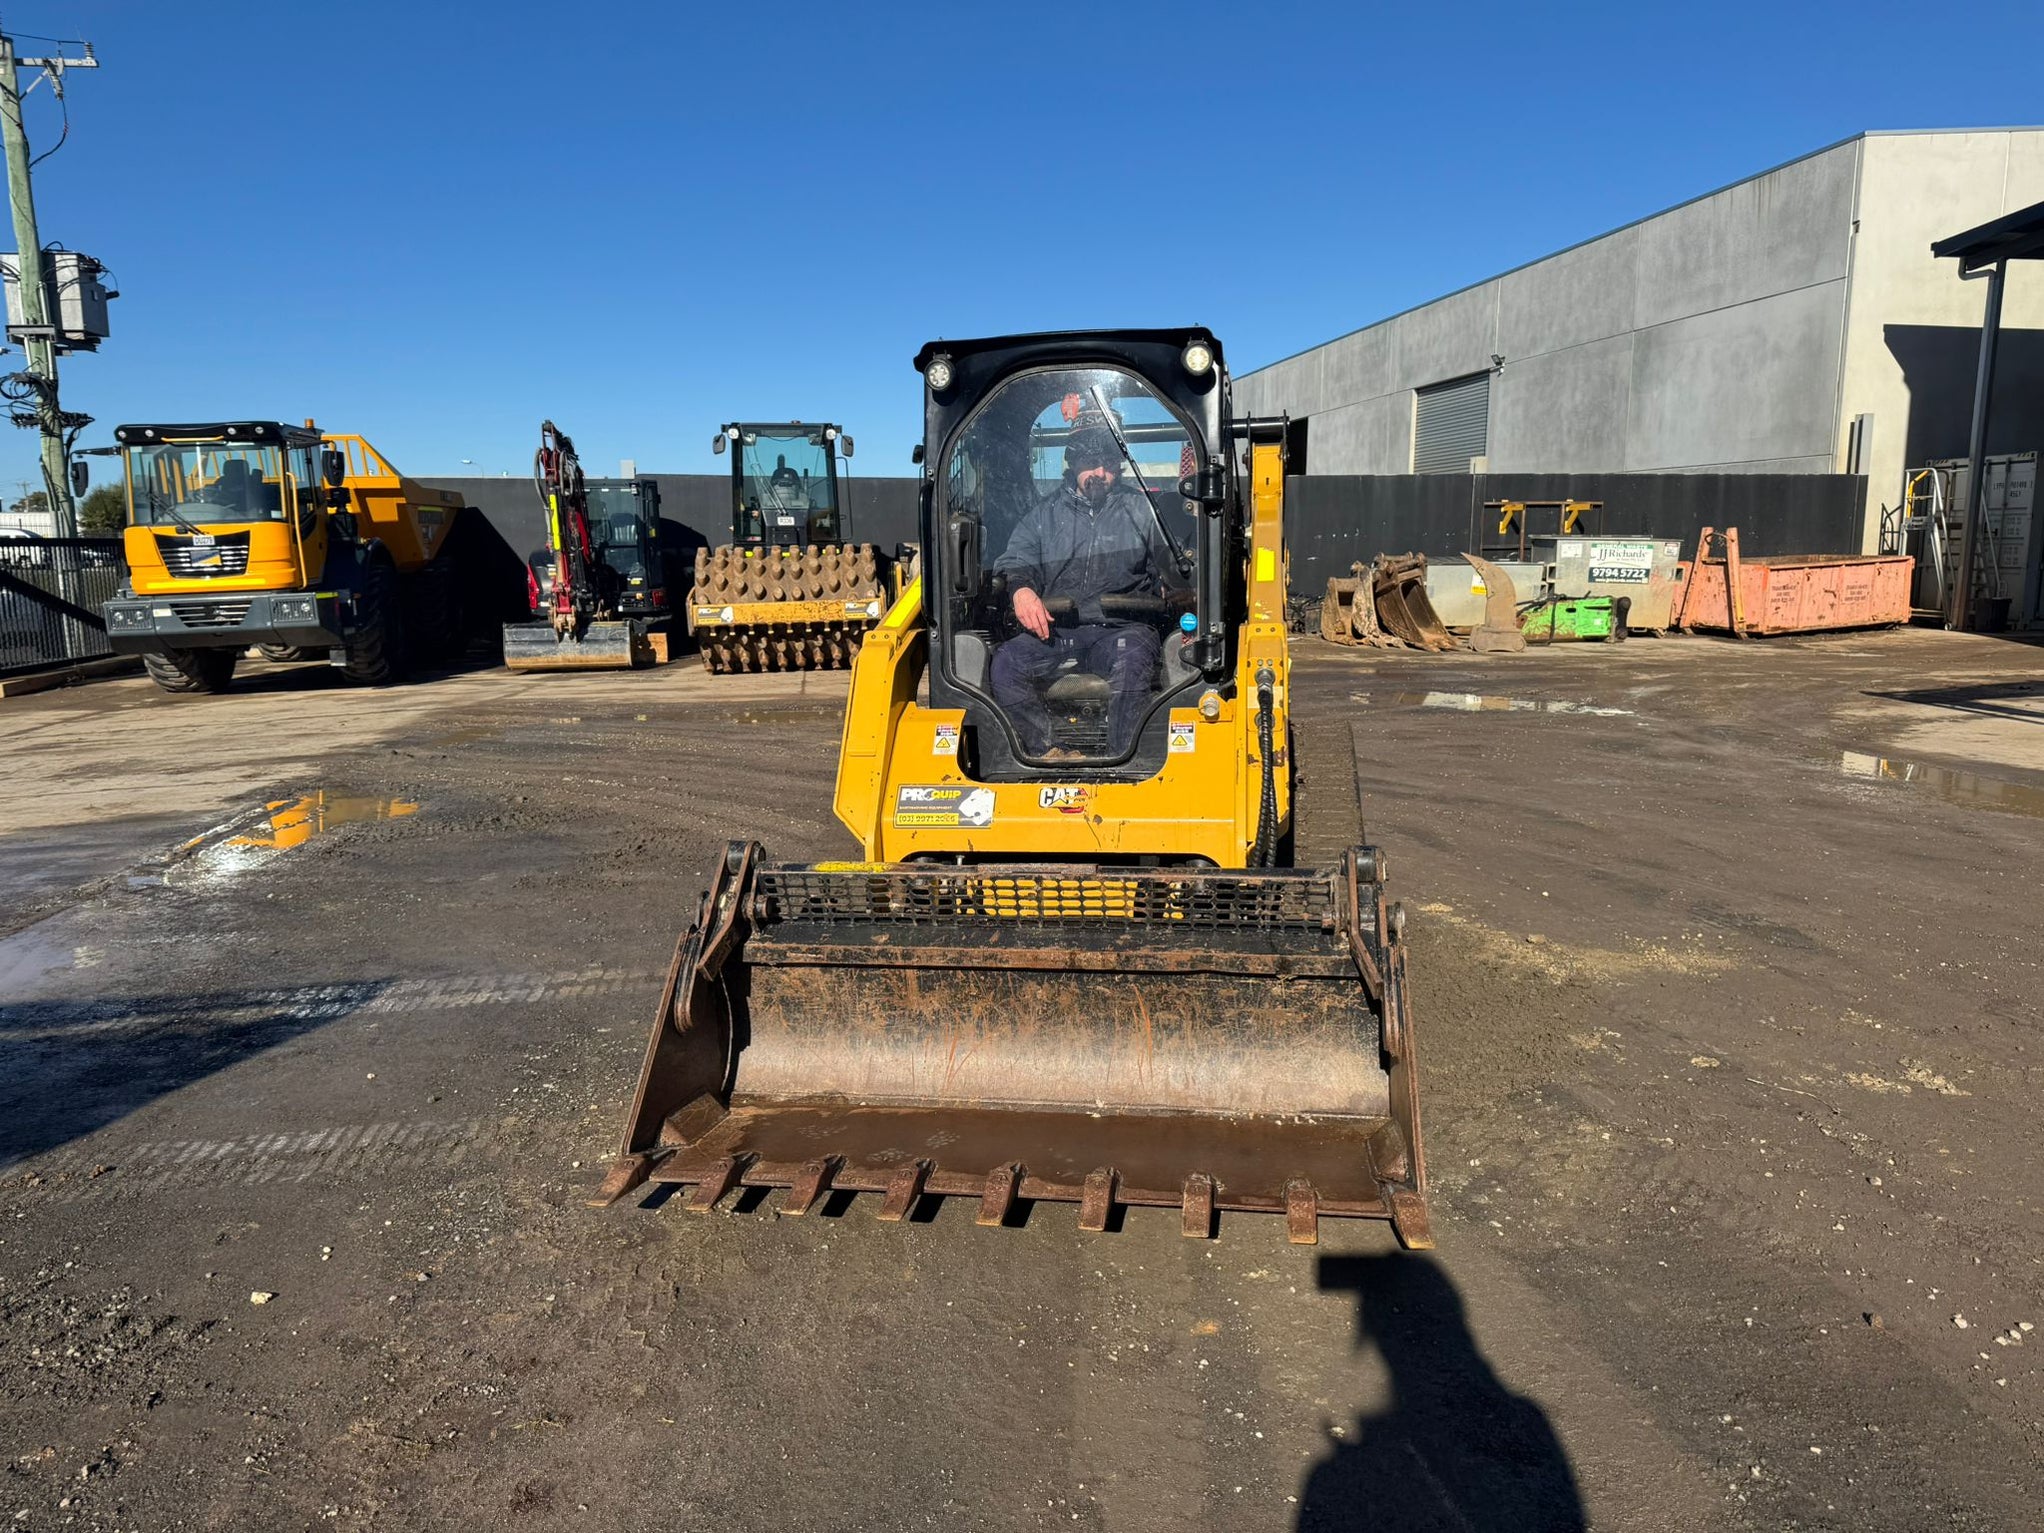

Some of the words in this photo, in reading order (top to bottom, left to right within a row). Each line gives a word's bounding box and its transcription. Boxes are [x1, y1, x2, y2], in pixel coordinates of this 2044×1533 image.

[1597, 548, 1608, 561] JJ
[1609, 549, 1646, 558] Richards
[1592, 568, 1619, 577] 9794
[1620, 569, 1646, 578] 5722
[900, 787, 962, 801] PROQUIP
